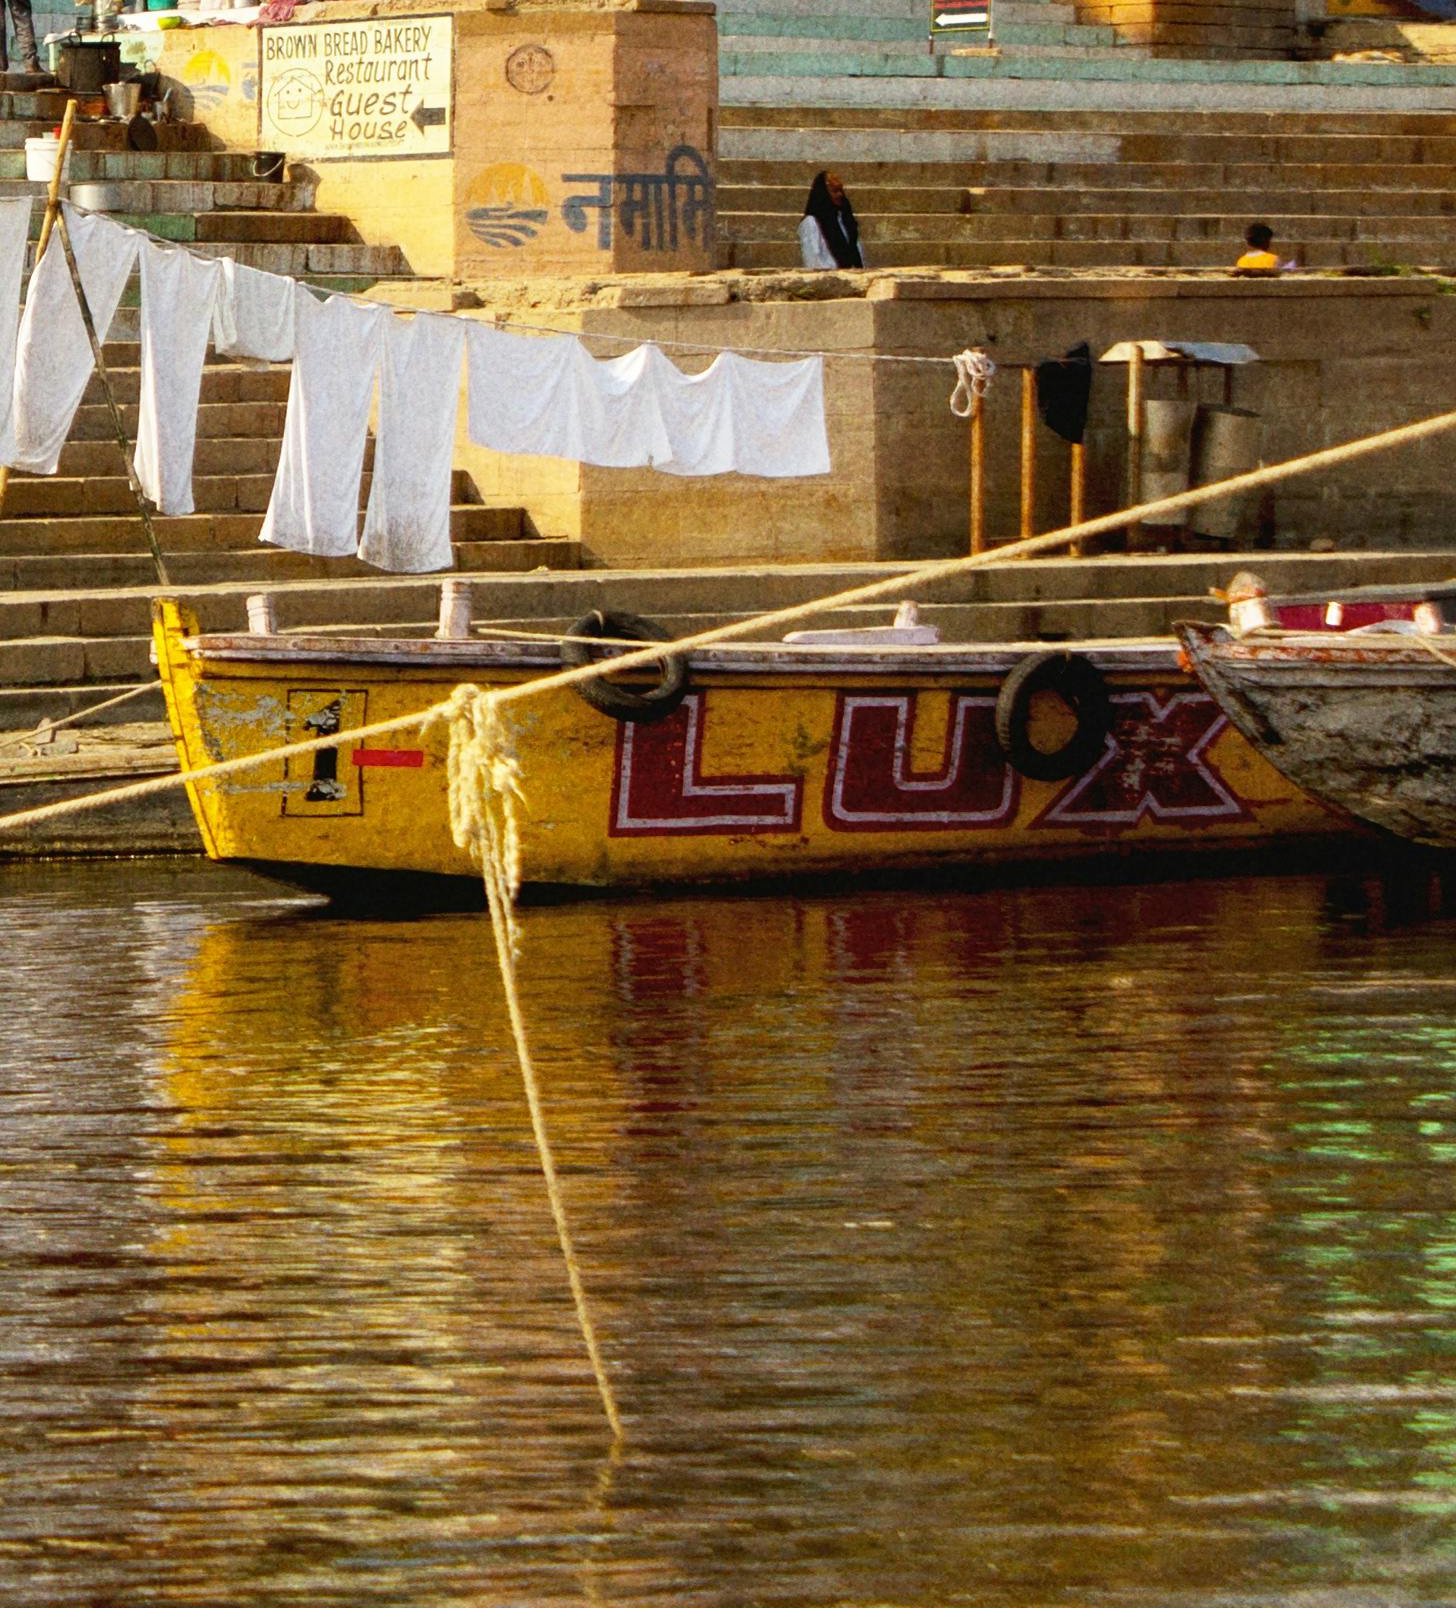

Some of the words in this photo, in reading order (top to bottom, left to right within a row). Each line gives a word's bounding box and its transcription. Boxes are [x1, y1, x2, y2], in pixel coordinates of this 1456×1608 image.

[266, 33, 318, 61] BROWN
[324, 29, 368, 57] BREAD
[374, 25, 432, 56] BAKERY
[325, 52, 433, 86] Restaurant
[329, 83, 413, 118] Guest
[329, 120, 408, 141] House
[560, 145, 716, 252] नमामि
[608, 688, 1253, 839] LUX
